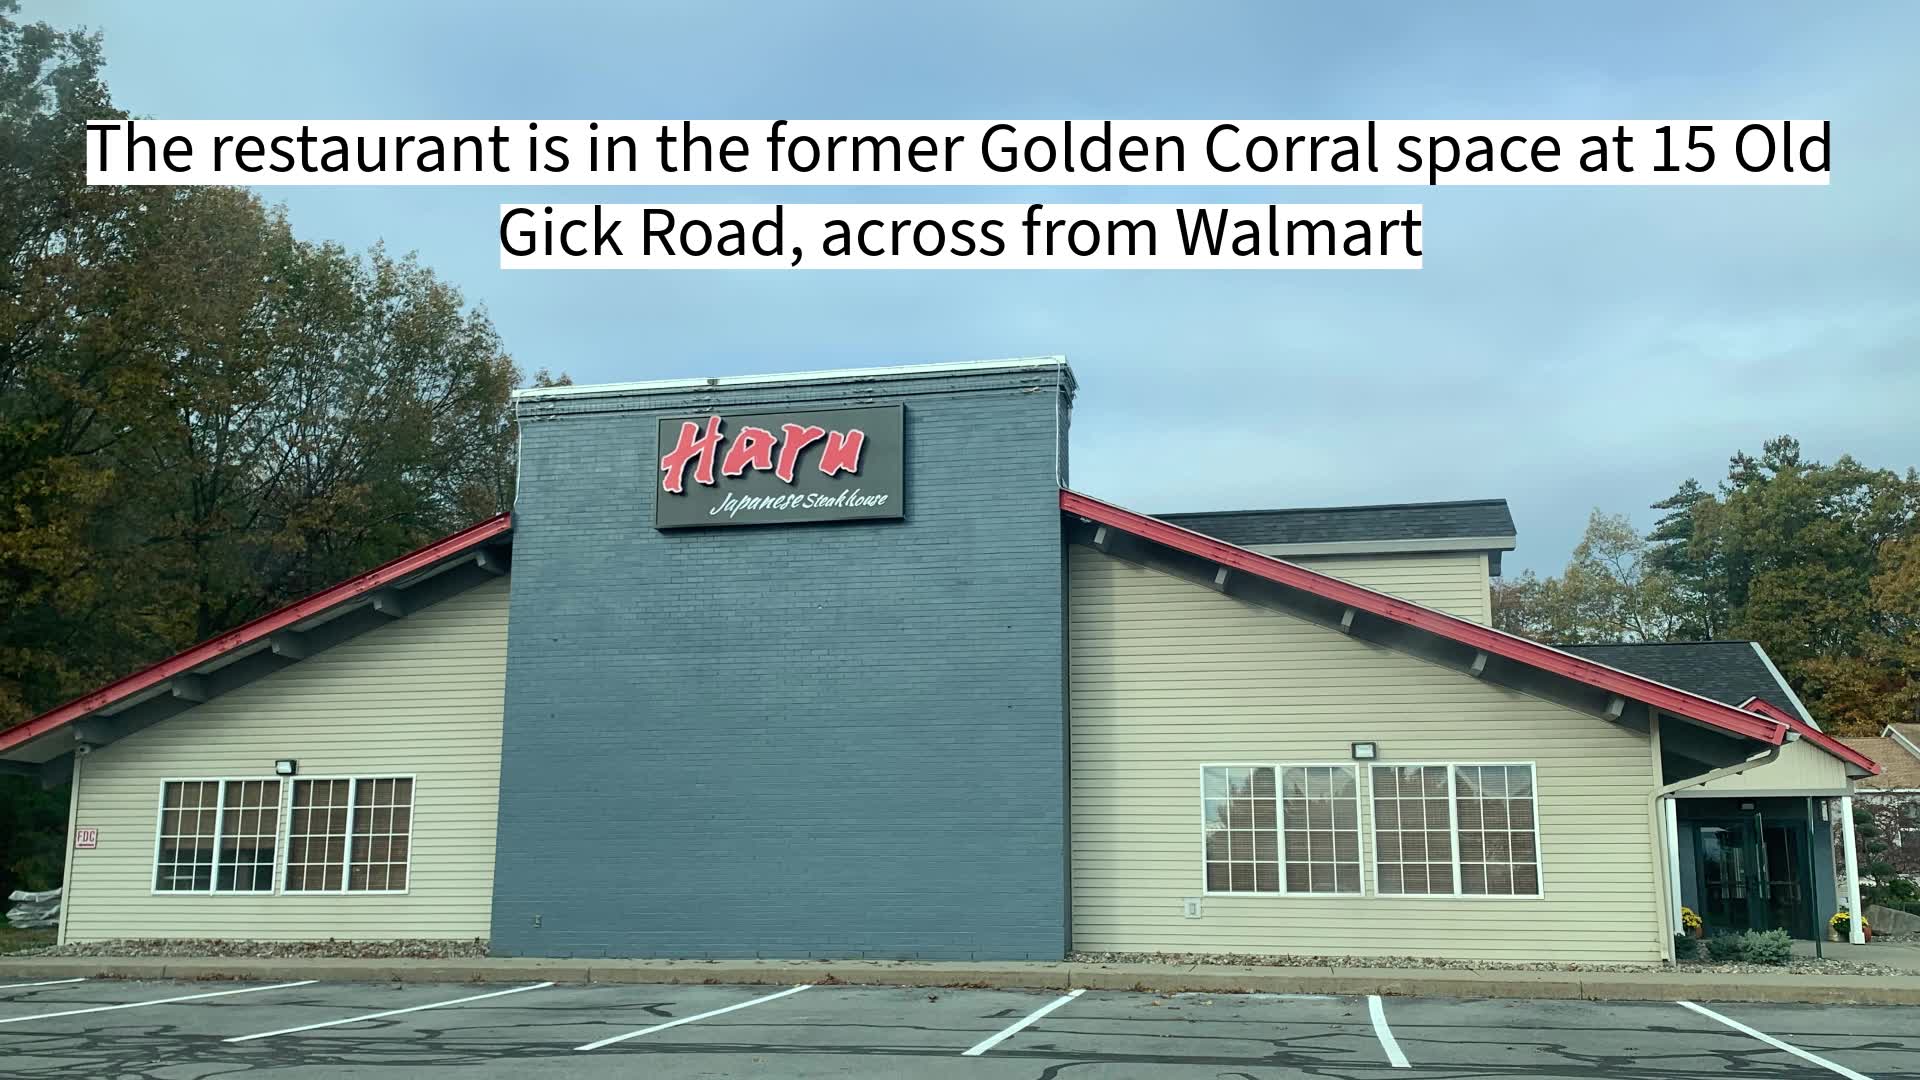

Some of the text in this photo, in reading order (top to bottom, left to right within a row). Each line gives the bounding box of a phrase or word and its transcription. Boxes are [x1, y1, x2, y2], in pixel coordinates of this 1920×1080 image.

[661, 415, 865, 493] Haru
[709, 493, 804, 518] Japanese
[77, 830, 95, 842] FDC
